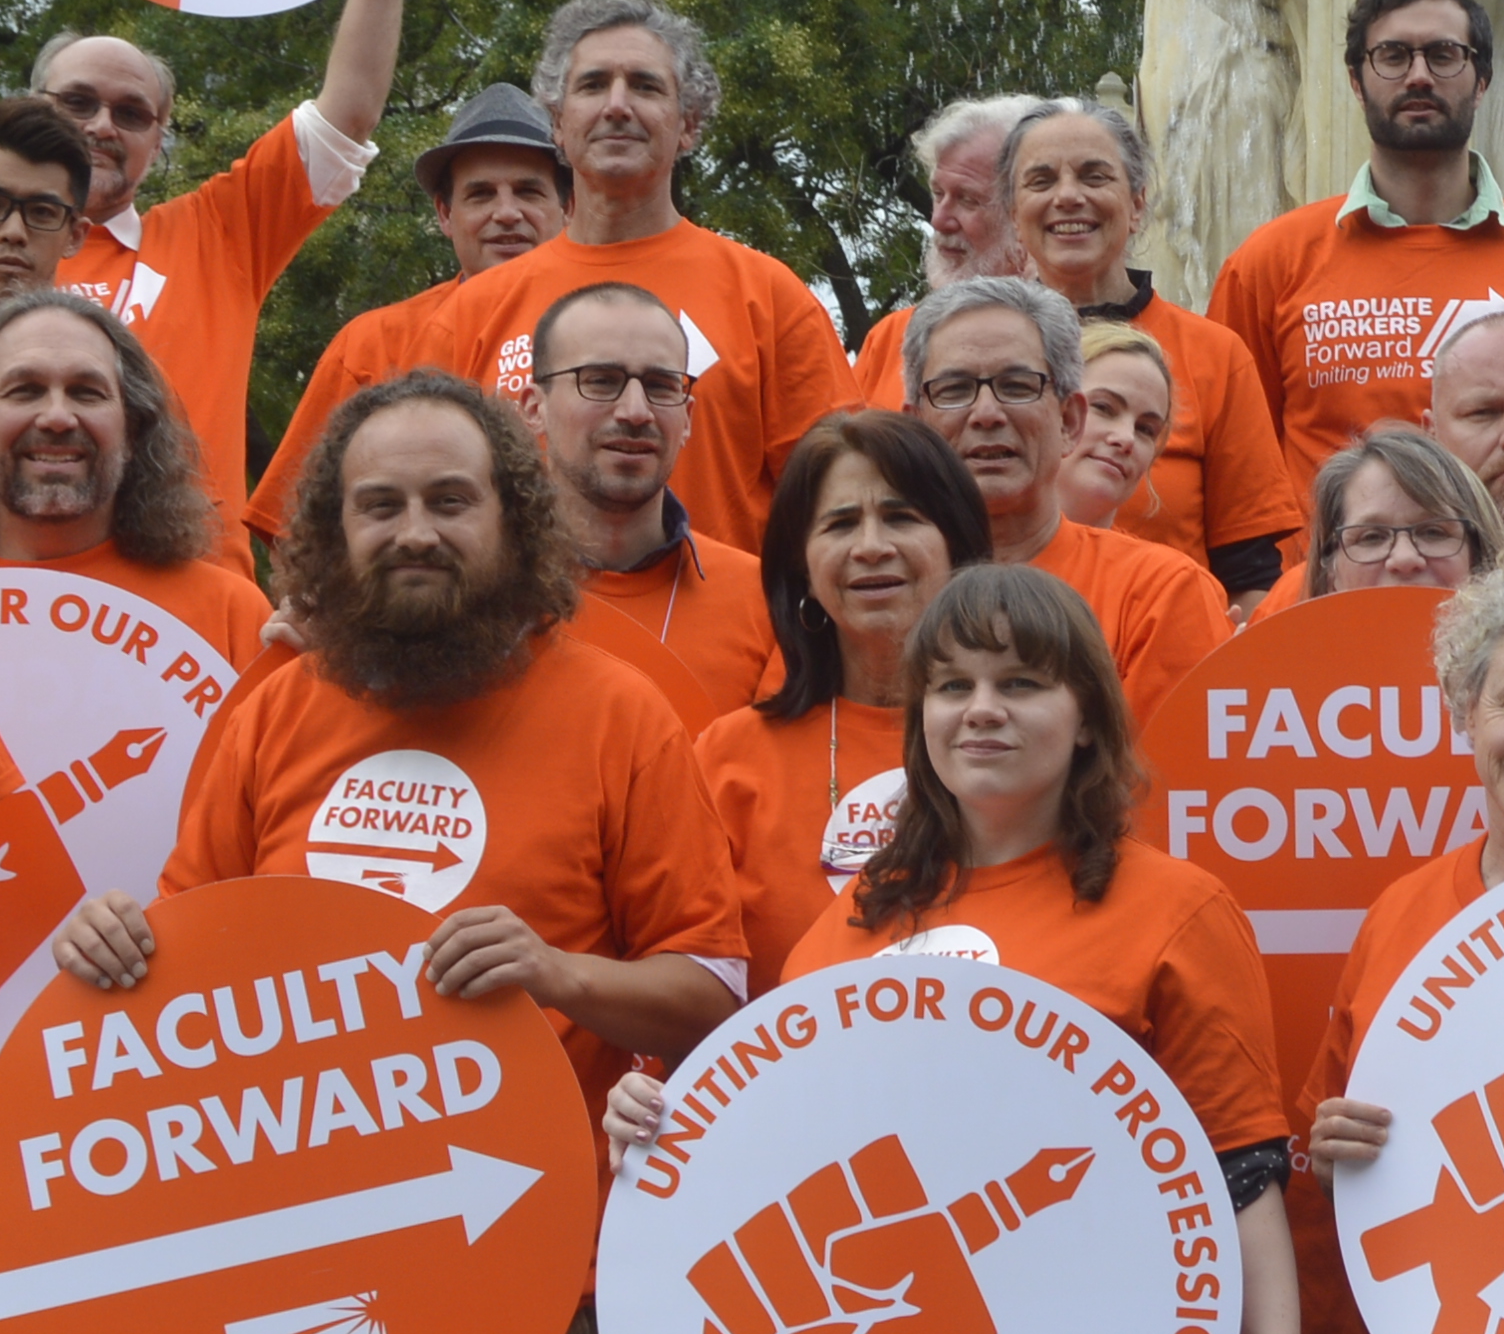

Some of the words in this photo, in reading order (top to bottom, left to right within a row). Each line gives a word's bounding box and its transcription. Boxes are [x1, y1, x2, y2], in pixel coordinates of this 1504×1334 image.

[1303, 297, 1432, 323] GRADUATE
[1304, 317, 1421, 343] WORKERS
[1305, 336, 1412, 367] Forward
[1308, 365, 1369, 388] Uniting
[1376, 361, 1414, 379] with
[49, 593, 159, 665] OUR
[1207, 685, 1474, 760] FACU
[343, 778, 469, 809] FACULTY
[324, 806, 472, 839] FORWARD
[42, 942, 428, 1100] FACULTY
[635, 1005, 818, 1199] UNITING
[834, 977, 946, 1029] FOR
[968, 986, 1090, 1074] OUR
[18, 1039, 502, 1211] FORWARD
